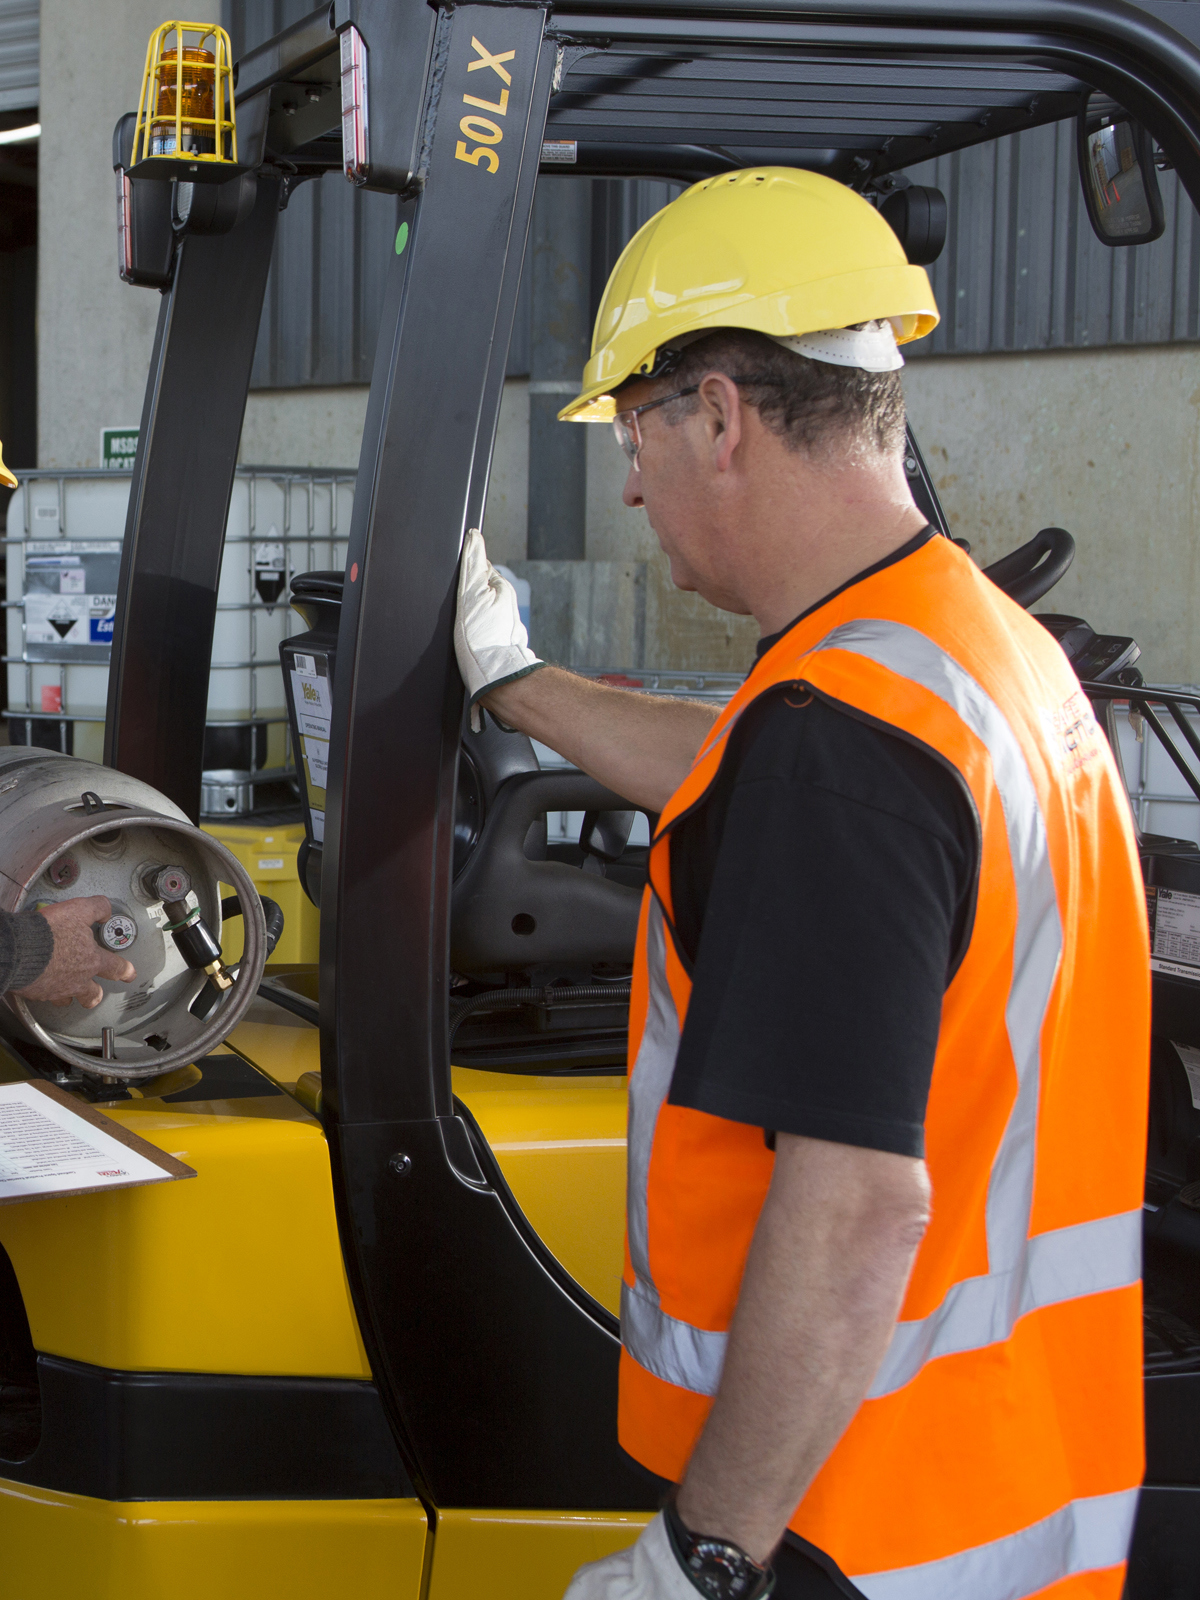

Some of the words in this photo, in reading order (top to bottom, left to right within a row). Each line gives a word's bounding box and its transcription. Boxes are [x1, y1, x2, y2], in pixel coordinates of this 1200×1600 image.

[455, 35, 516, 174] 50LX
[302, 682, 317, 701] Yale
[1159, 888, 1173, 900] Yale
[1158, 963, 1177, 974] Standard
